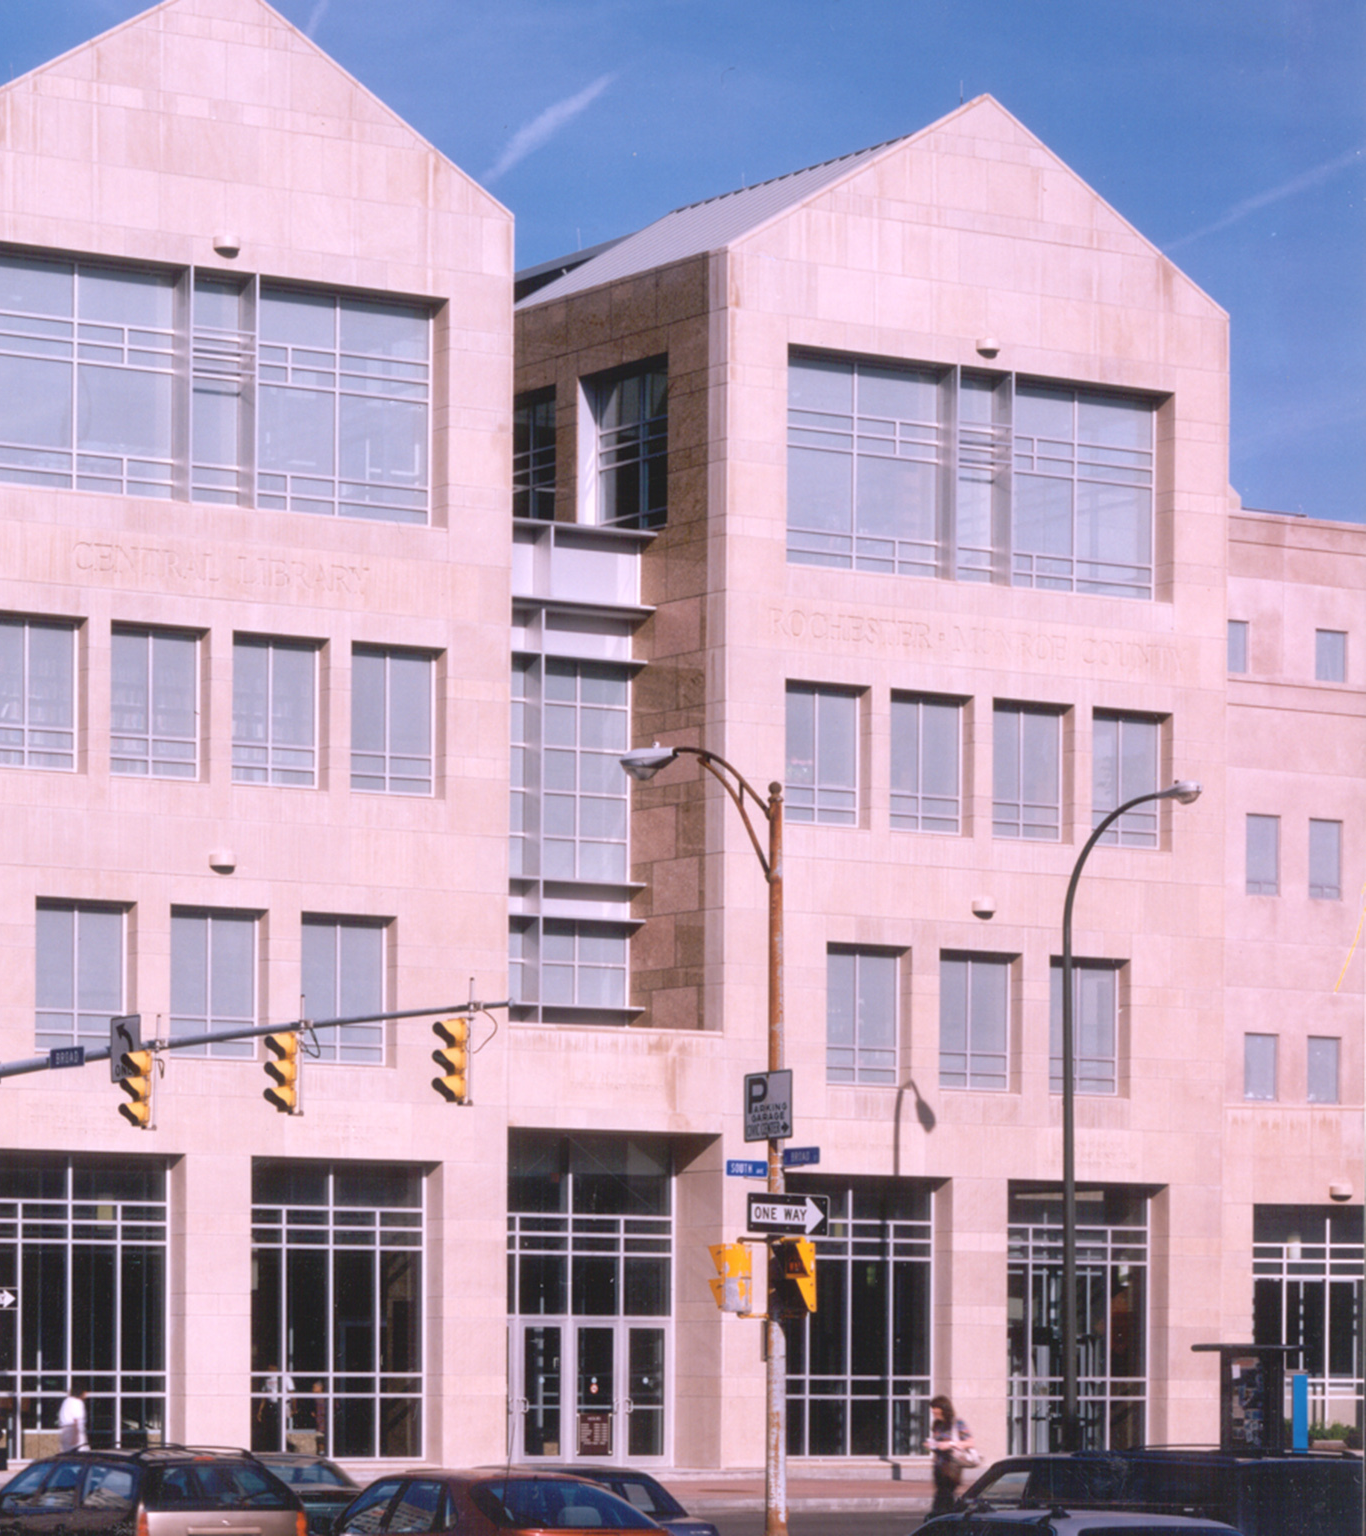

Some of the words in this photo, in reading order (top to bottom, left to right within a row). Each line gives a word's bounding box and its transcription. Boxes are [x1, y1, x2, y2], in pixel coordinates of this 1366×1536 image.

[73, 541, 220, 582] CENTRAL
[237, 555, 371, 595] LIBRARY
[768, 606, 933, 649] ROCHESTER
[952, 625, 1068, 662] MONROE
[1080, 637, 1186, 674] COUNTY
[56, 1051, 79, 1065] BROAD
[752, 1111, 785, 1122] GARAGE
[761, 1121, 781, 1135] CENTER
[790, 1151, 810, 1162] BROAD
[731, 1163, 753, 1174] SOUTH
[754, 1206, 777, 1220] ONE
[784, 1208, 807, 1221] WAY
